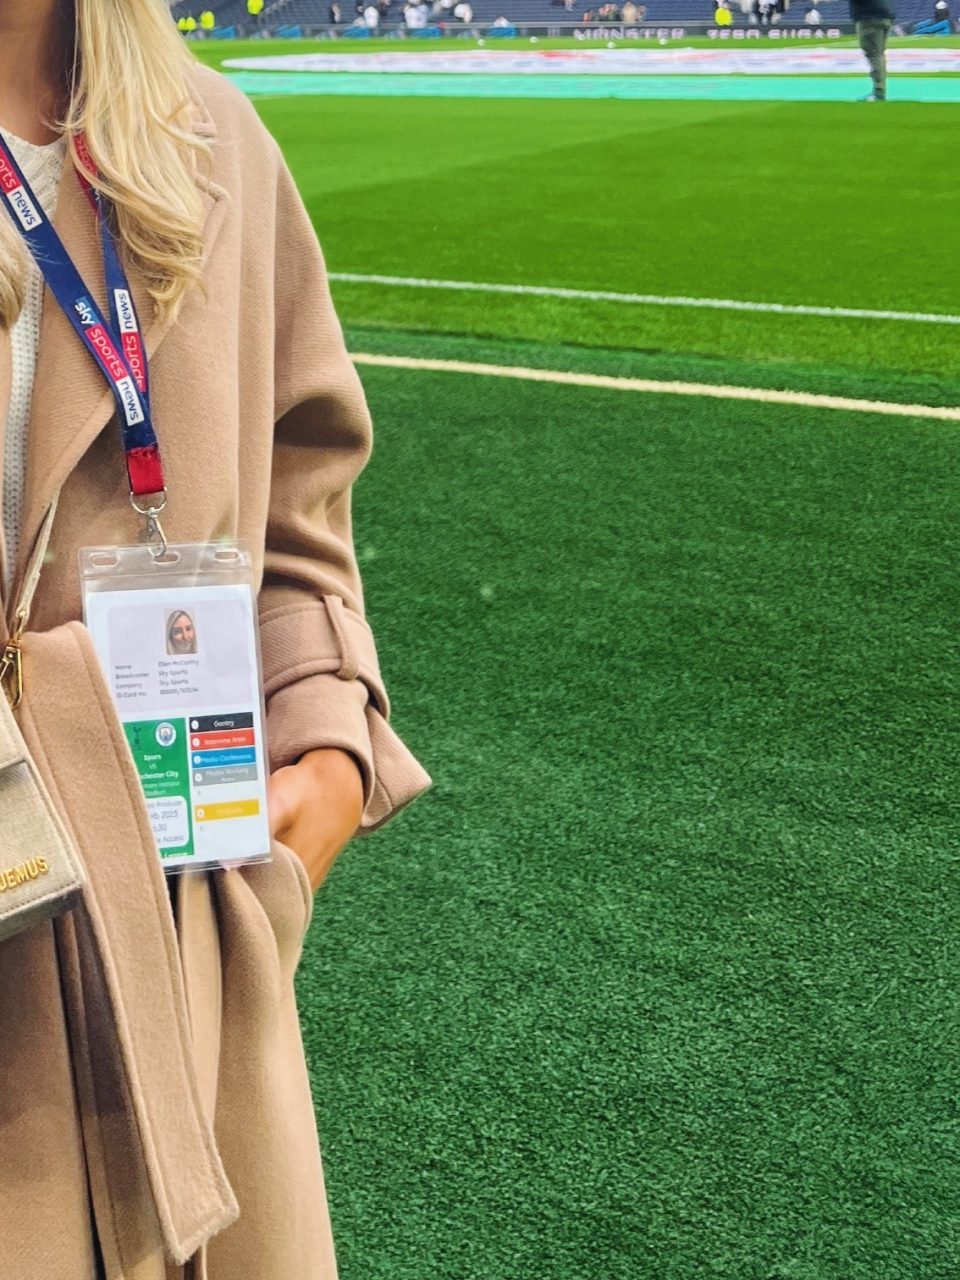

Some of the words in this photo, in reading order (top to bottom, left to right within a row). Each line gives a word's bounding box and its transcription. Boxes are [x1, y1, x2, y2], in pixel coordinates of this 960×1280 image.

[573, 27, 685, 40] MONSTER
[707, 28, 760, 39] ZERO
[768, 28, 841, 39] SUGAR
[12, 190, 37, 226] news
[119, 292, 134, 330] news
[74, 301, 96, 325] sky
[90, 328, 123, 377] sports
[120, 381, 139, 421] news
[165, 770, 179, 778] City
[161, 810, 178, 819] 2023
